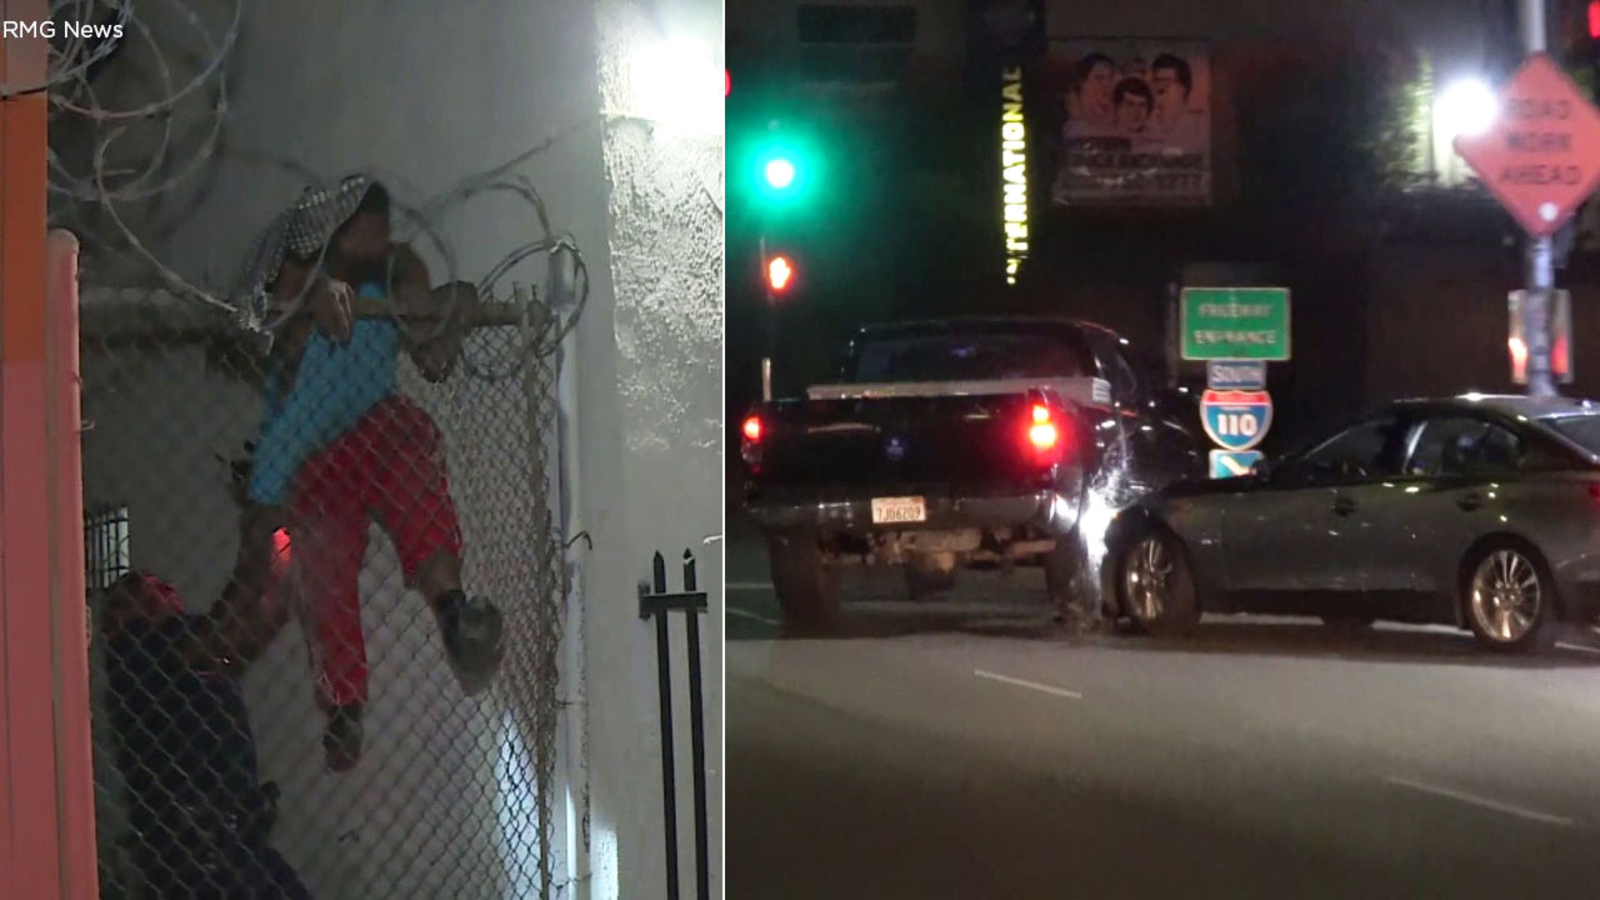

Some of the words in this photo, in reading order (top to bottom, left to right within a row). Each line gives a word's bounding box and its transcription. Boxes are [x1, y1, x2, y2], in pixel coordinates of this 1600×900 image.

[1506, 99, 1571, 119] ROAD
[1507, 132, 1571, 152] WORK
[1502, 165, 1581, 185] AHEAD
[1200, 304, 1271, 317] FREEWAY
[1194, 330, 1276, 343] ENTRANCE
[1211, 365, 1263, 382] SOUTH
[1216, 413, 1258, 436] 110
